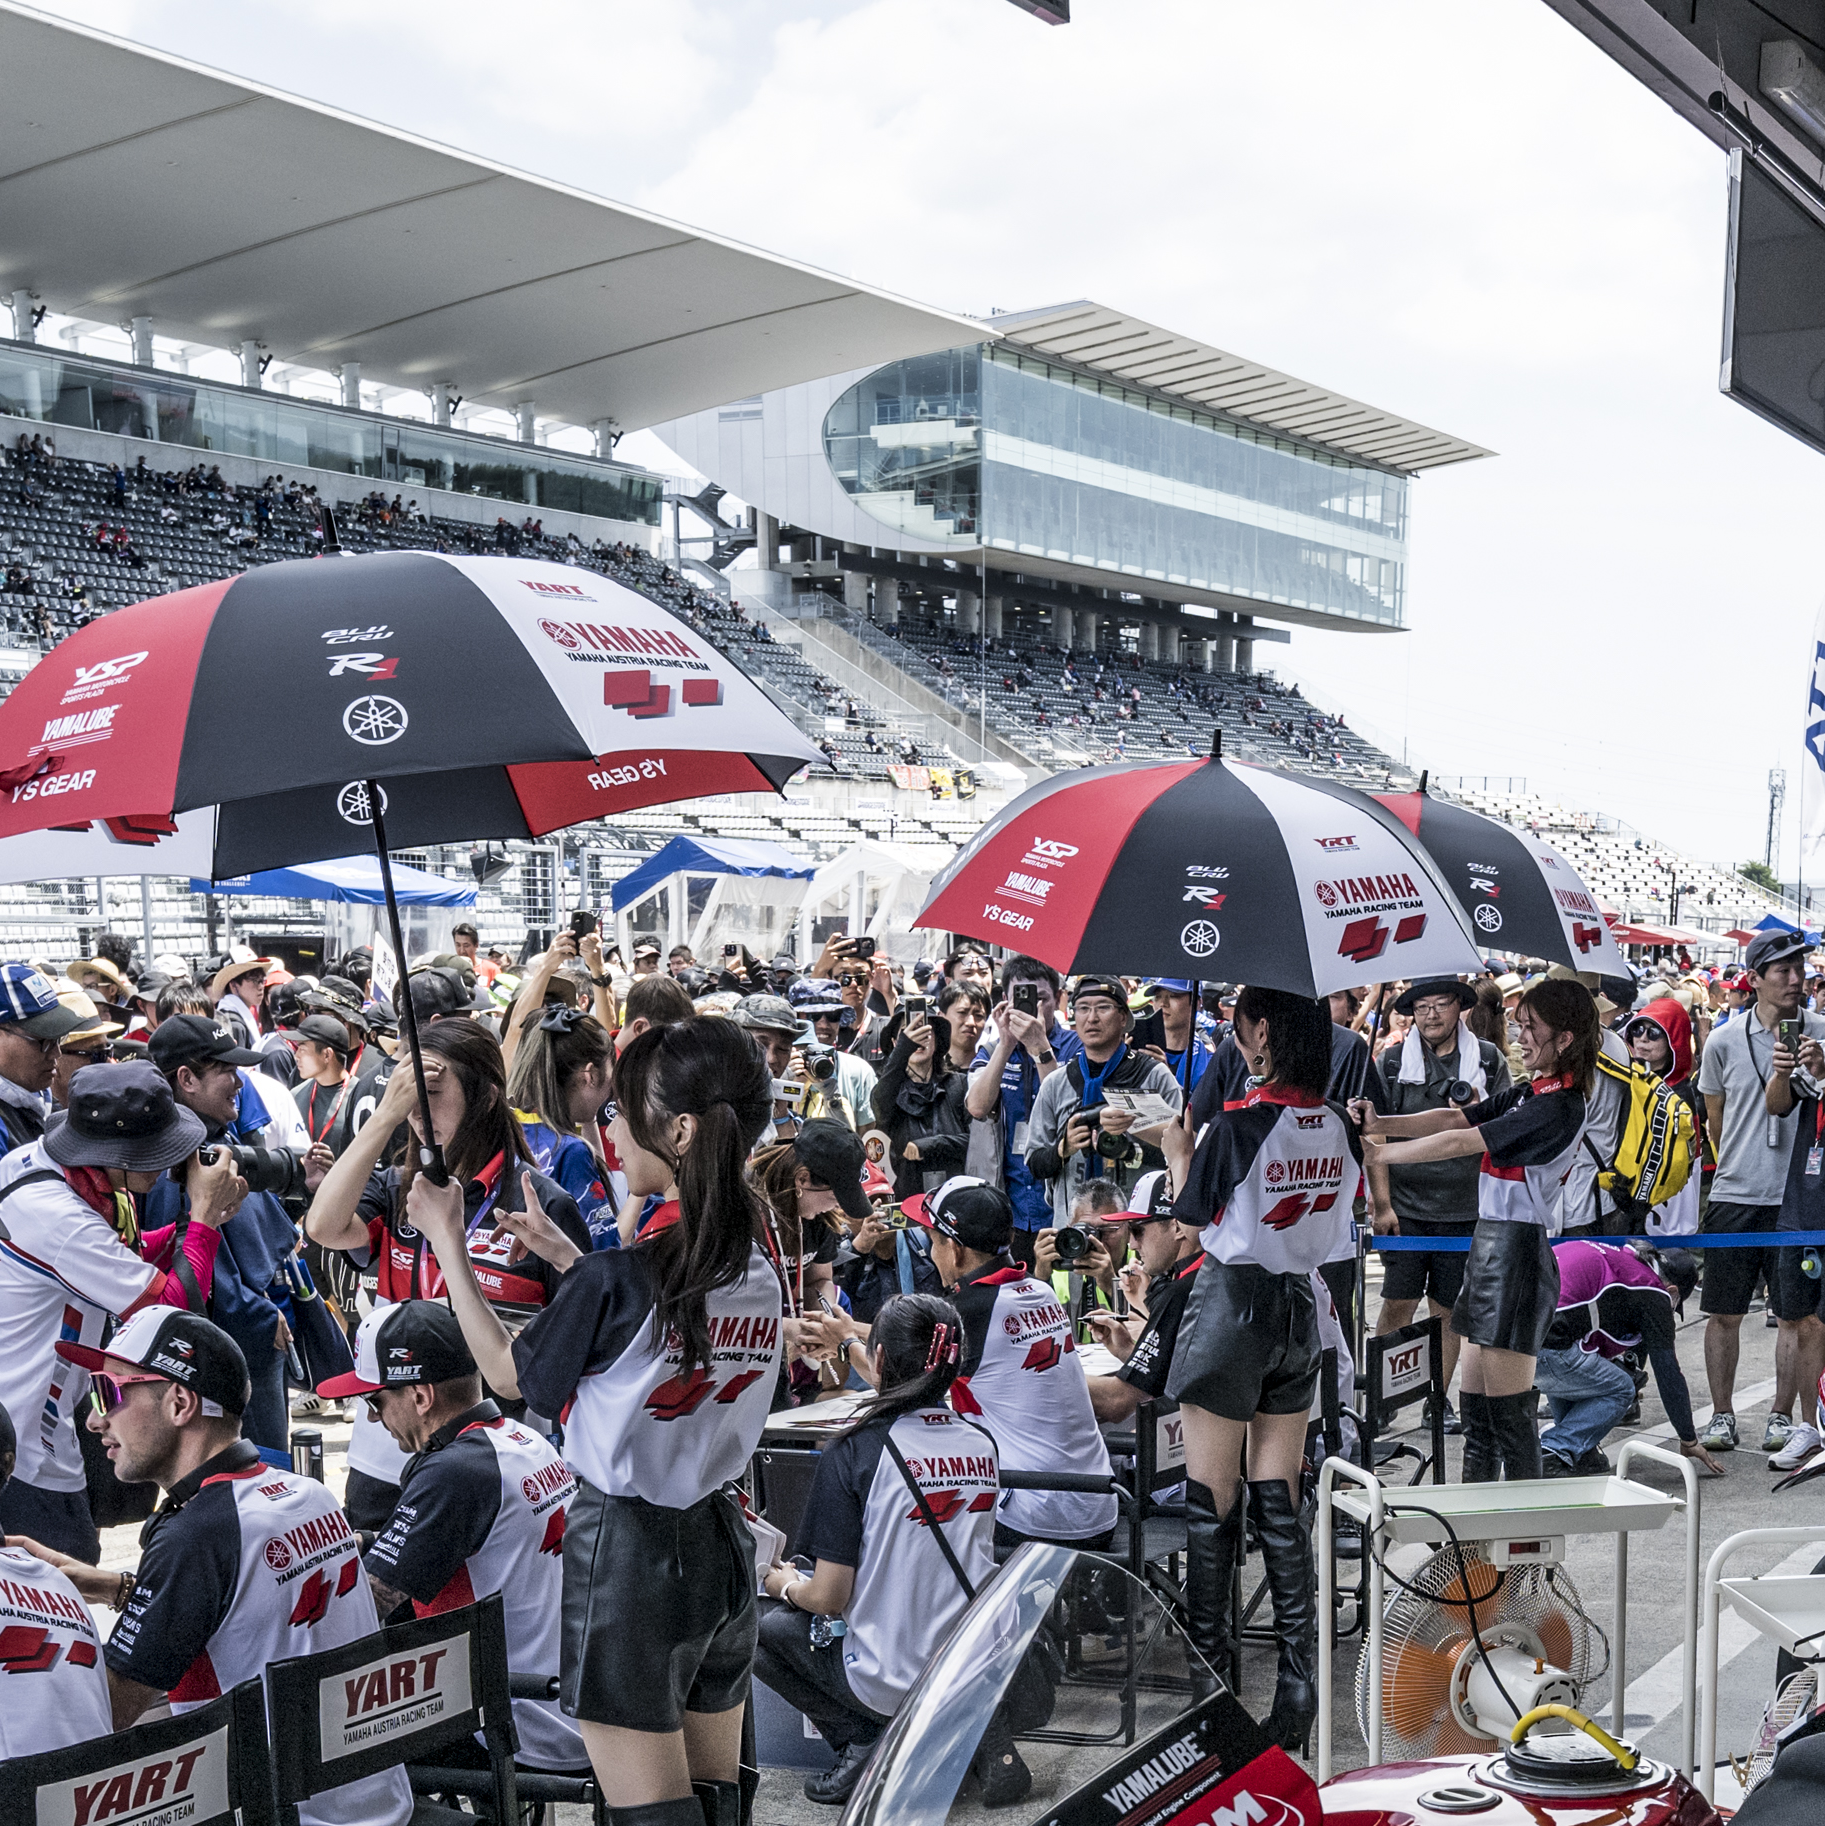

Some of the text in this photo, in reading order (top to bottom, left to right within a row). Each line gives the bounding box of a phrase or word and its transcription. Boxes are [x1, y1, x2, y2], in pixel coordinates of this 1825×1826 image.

[517, 580, 585, 596] YART
[321, 625, 389, 638] BLU
[325, 632, 396, 645] CRU
[565, 621, 697, 659] YAMAHA
[73, 651, 149, 687] YSP
[327, 652, 400, 682] R1
[565, 651, 712, 673] YAMAHA AUSTRIA RACING TEAM
[41, 704, 119, 742] YAMALUBE
[12, 769, 97, 803] Y'S GEAR
[1031, 836, 1079, 859] YSP
[1314, 836, 1356, 849] YRT
[1004, 871, 1053, 897] YAMALUBE
[1333, 873, 1421, 905] YAMAHA
[1182, 885, 1228, 911] R1
[1324, 900, 1424, 919] YAMAHA RACING TEAM
[999, 909, 1035, 932] GEAR
[1295, 1114, 1325, 1126] YRT
[1288, 1157, 1344, 1181] YAMAHA
[1265, 1183, 1297, 1194] YAMAHA
[1638, 1167, 1655, 1203] YAMAHA
[168, 1336, 195, 1358] R1
[389, 1347, 414, 1362] R1
[153, 1352, 198, 1376] YART
[386, 1364, 423, 1376] YART
[1388, 1344, 1423, 1376] YRT
[923, 1456, 996, 1478] YAMAHA
[257, 1481, 290, 1499] YART
[946, 1479, 997, 1488] RACING TEAM
[284, 1509, 352, 1552] YAMAHA
[15, 1610, 50, 1626] AUSTRIA
[50, 1617, 80, 1633] RACING
[344, 1647, 448, 1719] YART
[344, 1700, 445, 1747] YAMAHA AUSTRIA RACING TEAM
[1101, 1735, 1206, 1816] YAMALUBE
[1162, 1798, 1184, 1818] Engine
[1183, 1771, 1222, 1801] Component
[172, 1801, 195, 1826] TEAM
